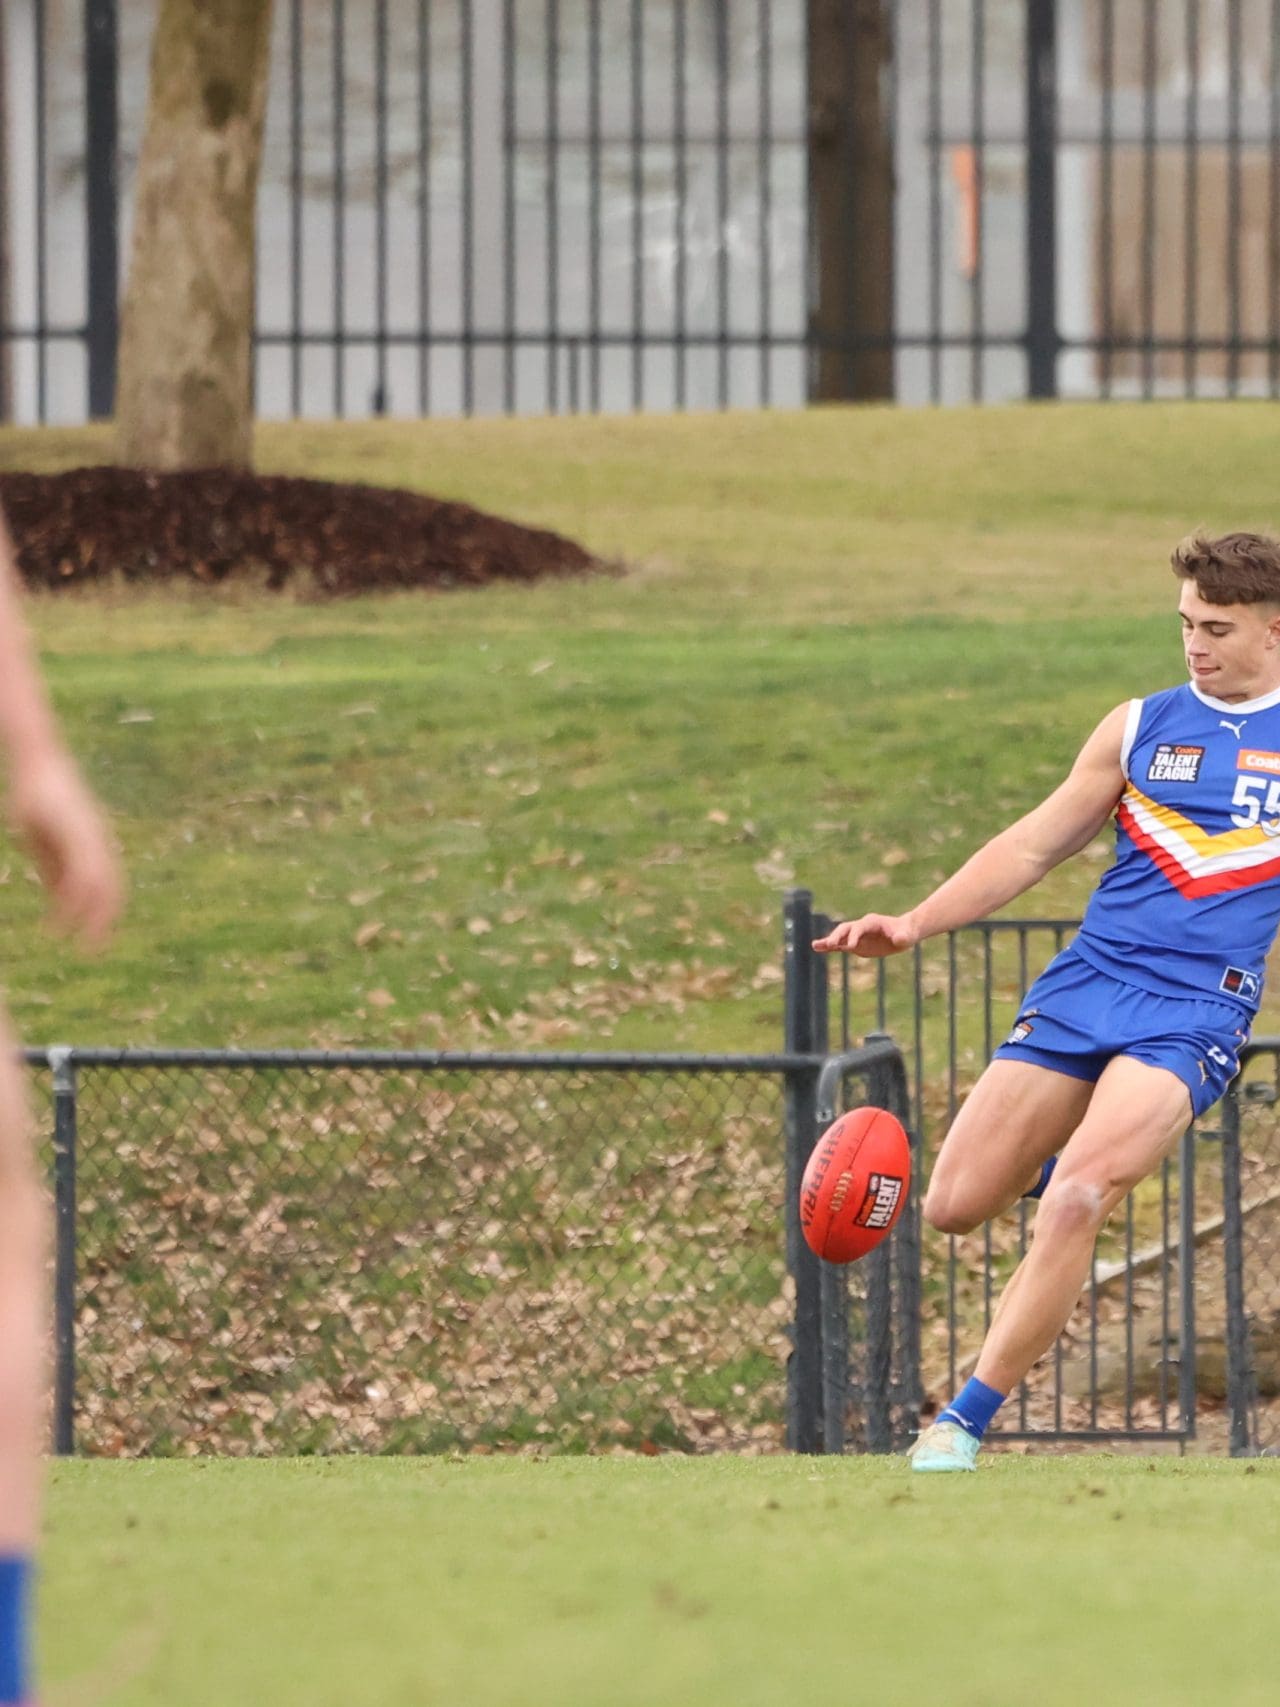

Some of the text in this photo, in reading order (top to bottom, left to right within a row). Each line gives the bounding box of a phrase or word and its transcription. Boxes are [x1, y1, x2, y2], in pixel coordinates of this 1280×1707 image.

[1154, 752, 1201, 767] TALENT
[1148, 765, 1198, 781] LEAGUE
[865, 1176, 897, 1227] TALENT
